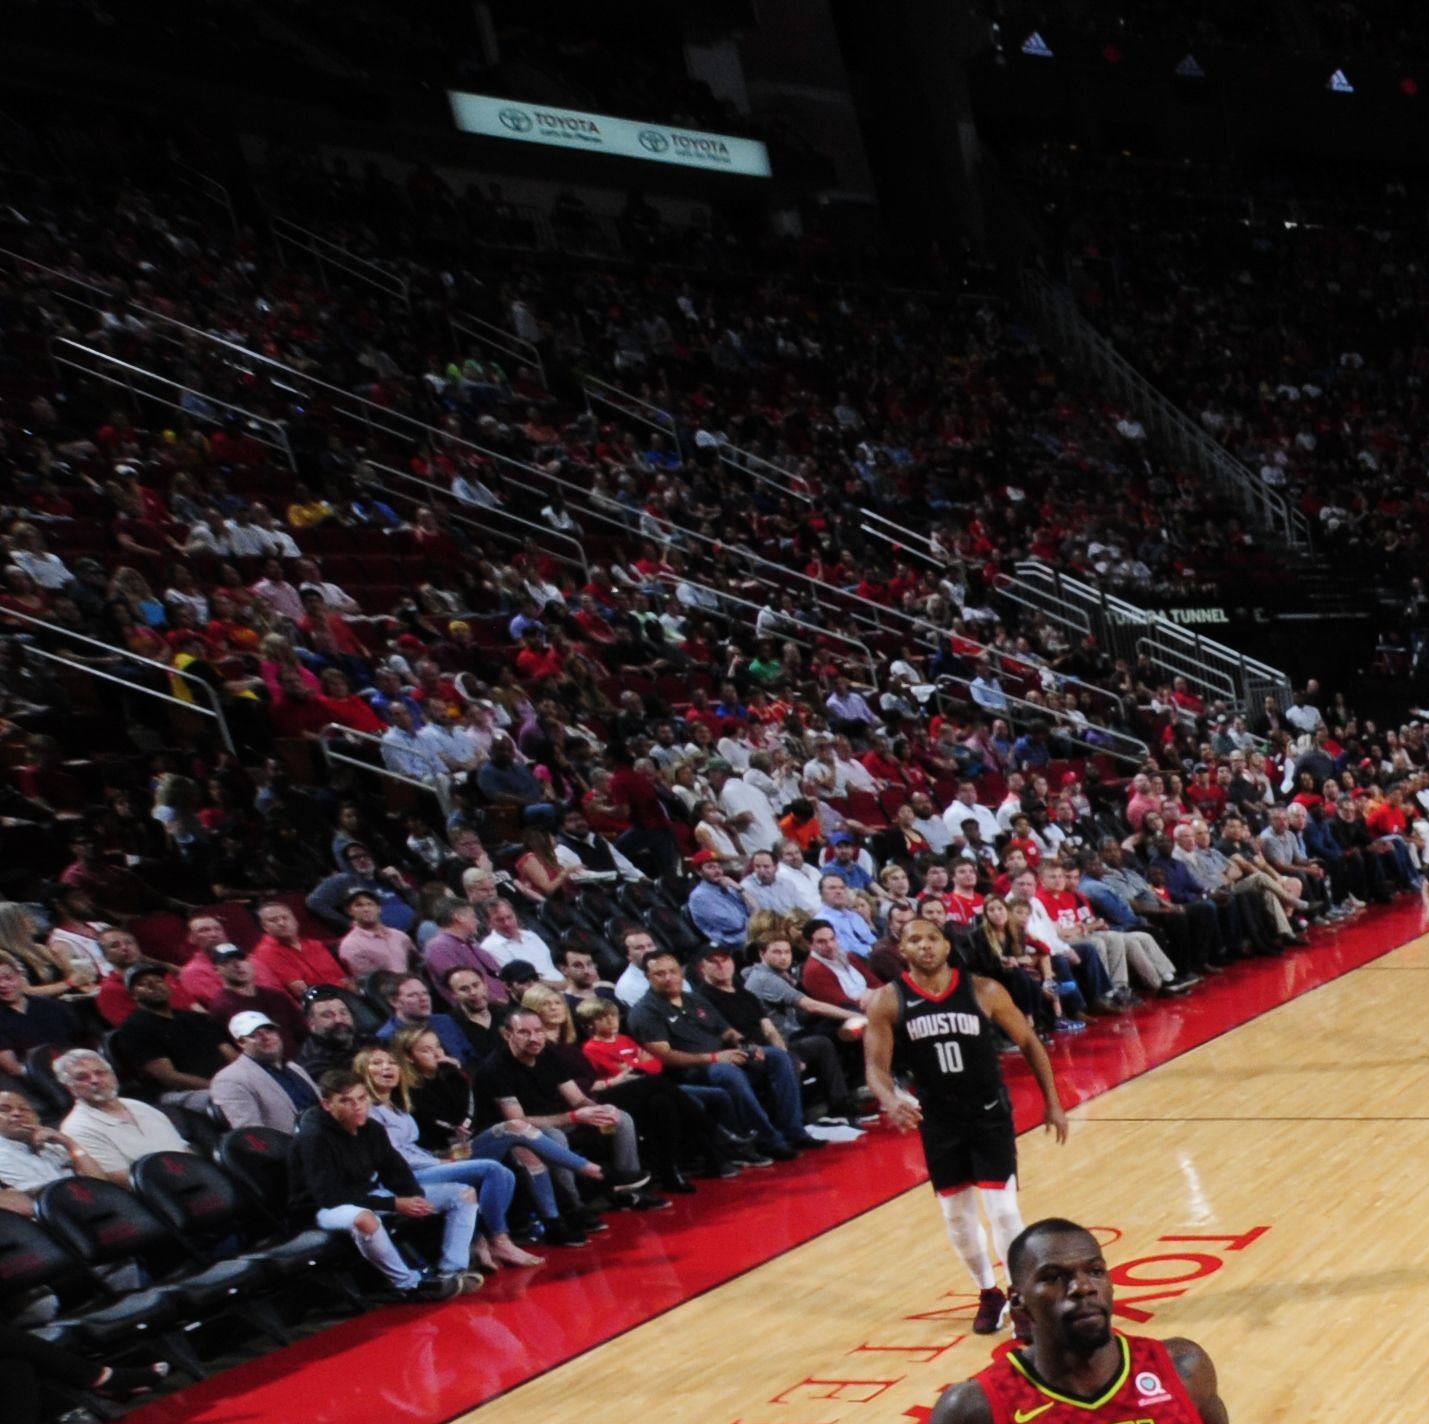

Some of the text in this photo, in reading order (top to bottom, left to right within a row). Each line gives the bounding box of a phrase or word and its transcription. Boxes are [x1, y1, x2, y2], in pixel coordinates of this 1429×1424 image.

[534, 111, 601, 135] TOYOTA
[671, 134, 729, 155] TOYOTA
[1169, 607, 1230, 624] TUNNEL
[905, 1011, 981, 1041] HOUSTON
[933, 1040, 964, 1073] 10
